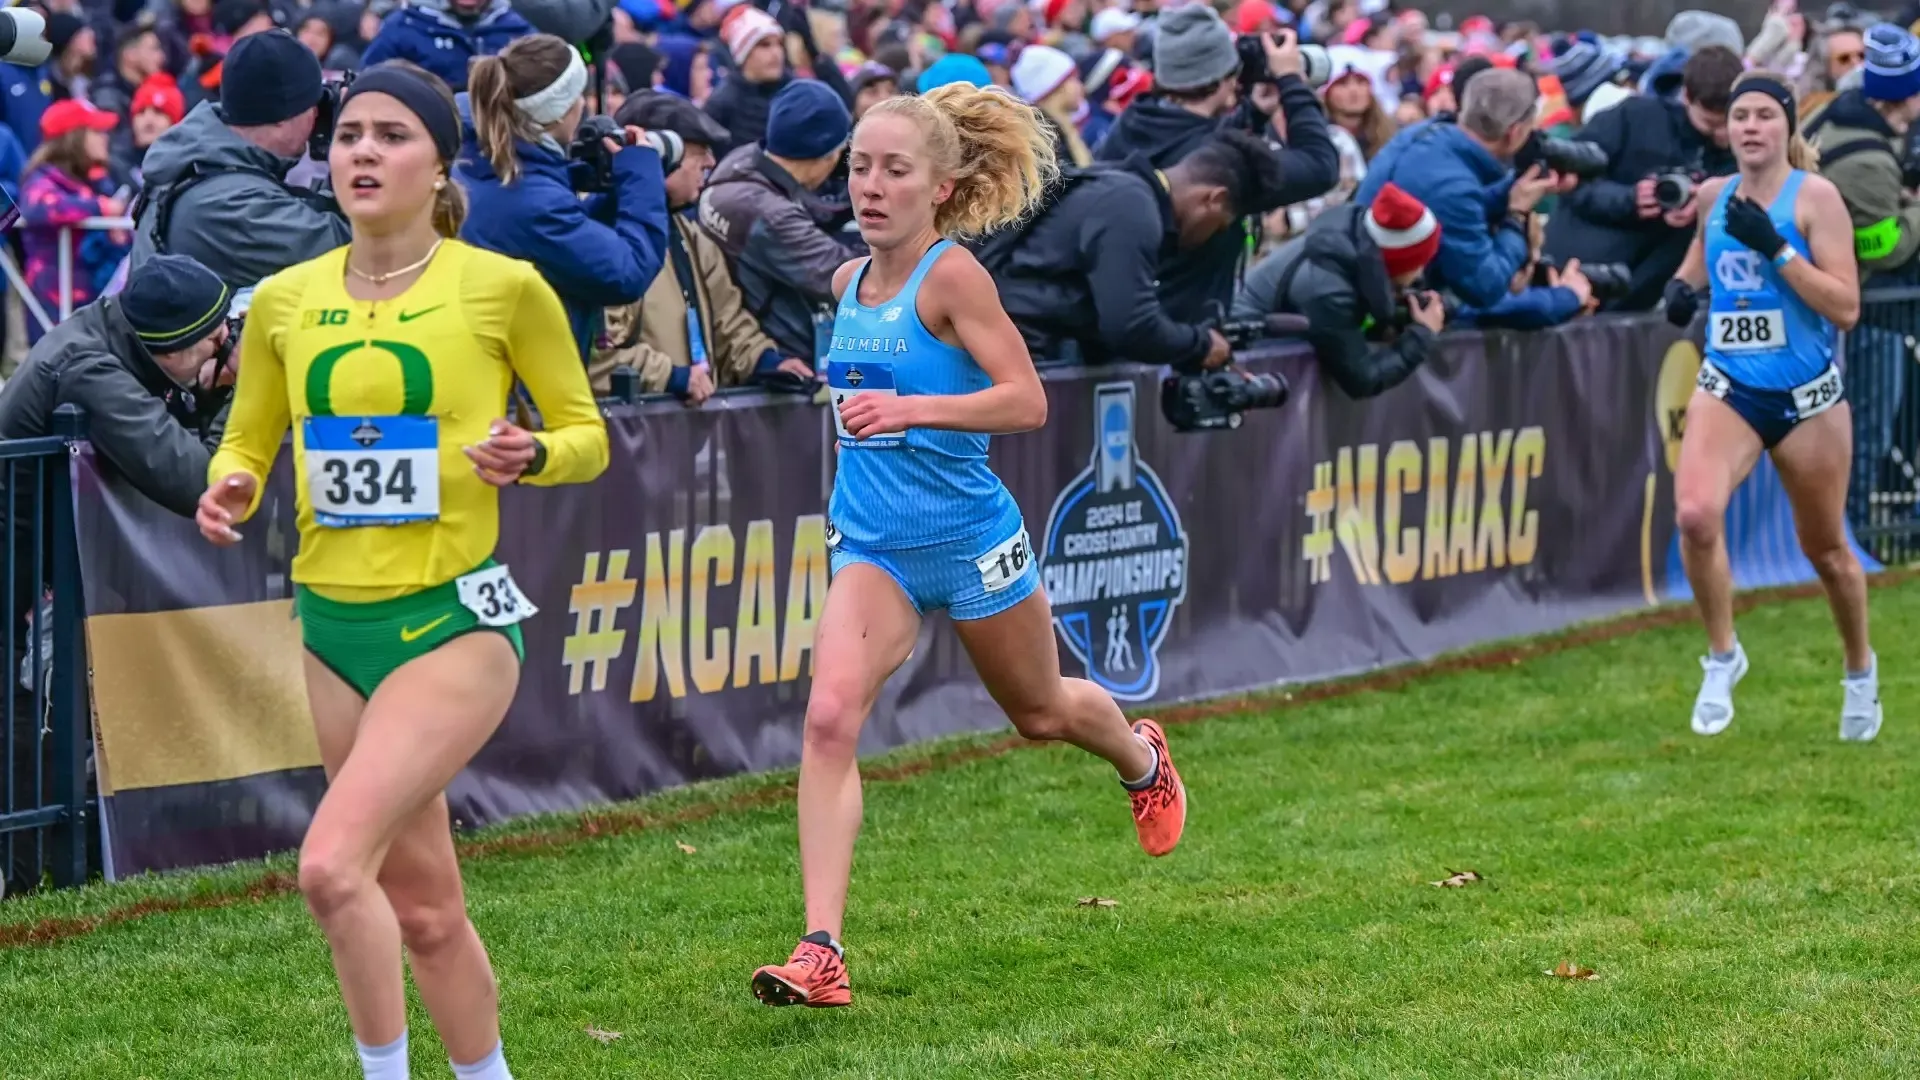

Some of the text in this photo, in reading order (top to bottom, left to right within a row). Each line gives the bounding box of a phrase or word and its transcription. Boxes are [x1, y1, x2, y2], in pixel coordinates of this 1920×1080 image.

[830, 334, 909, 353] OLUMBIA
[1720, 316, 1772, 344] 288
[323, 457, 418, 506] 334
[1085, 503, 1124, 529] 2024
[1302, 425, 1547, 585] #NCAAXC
[995, 531, 1029, 579] 160
[1063, 522, 1158, 557] CROSS COUNTRY
[477, 577, 520, 619] 33
[1043, 547, 1184, 607] CHAMPIONSHIPS
[562, 513, 828, 703] #NCAA
